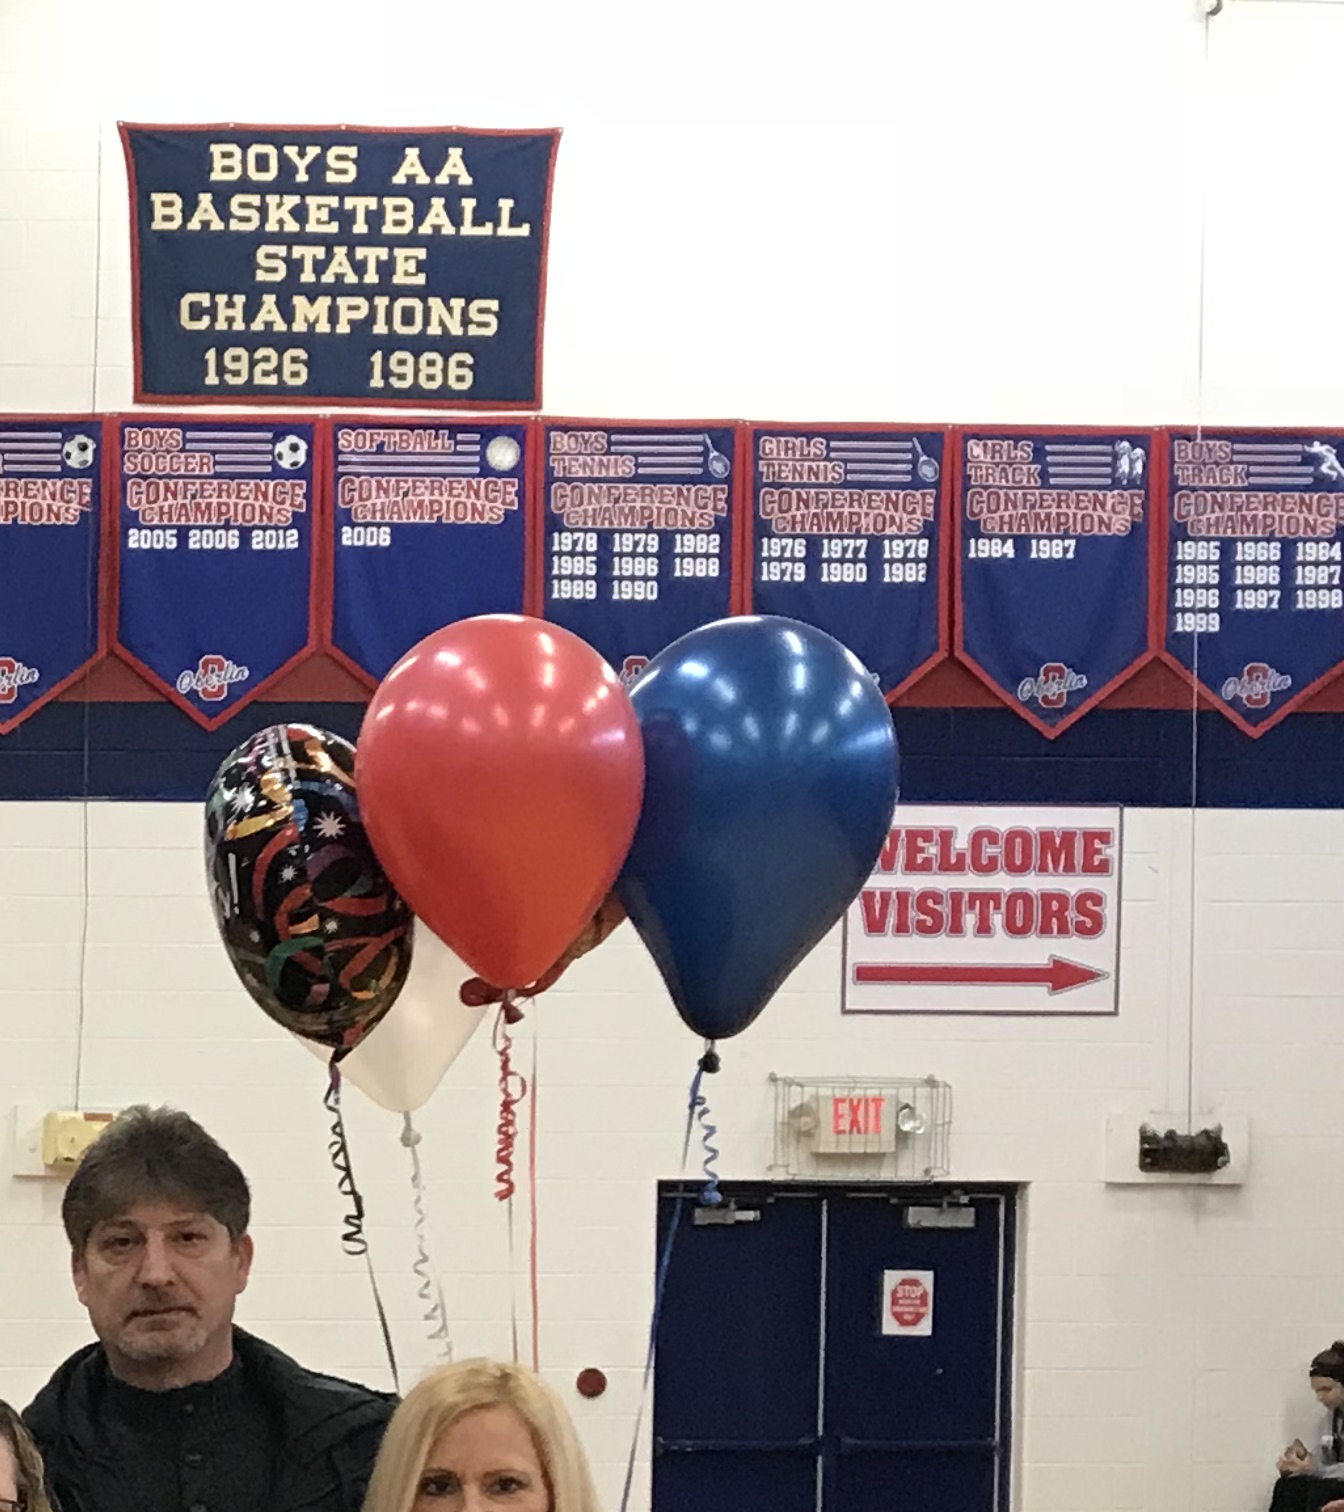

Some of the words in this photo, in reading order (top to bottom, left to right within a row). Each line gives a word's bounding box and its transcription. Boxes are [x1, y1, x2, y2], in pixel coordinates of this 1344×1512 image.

[210, 143, 358, 183] BOYS
[392, 148, 473, 185] AA
[151, 193, 530, 236] BASKETBALL
[255, 245, 426, 285] STATE
[179, 293, 499, 336] CHAMPIONS
[204, 347, 308, 386] 1926
[370, 350, 474, 390] 1986
[125, 428, 182, 450] BOYS
[338, 429, 454, 452] SOFTBALL
[550, 432, 608, 453] BOYS
[759, 437, 826, 459] GIRLS
[967, 440, 1033, 462] GIRLS
[1174, 440, 1233, 463] BOYS
[124, 453, 214, 474] SOCCER
[550, 456, 636, 477] TENNIS
[759, 461, 846, 483] TENNIS
[967, 464, 1041, 486] TRACK
[1174, 465, 1249, 487] TRACK
[127, 479, 307, 512] CONFERENCE
[339, 477, 518, 510] CONFERENCE
[551, 482, 728, 516] CONFERENCE
[760, 488, 937, 520] CONFERENCE
[140, 501, 293, 525] CHAMPIONS
[352, 499, 505, 524] CHAMPIONS
[564, 506, 715, 529] CHAMPIONS
[967, 489, 1145, 523] CONFERENCE
[773, 510, 924, 535] CHAMPIONS
[981, 512, 1131, 536] CHAMPIONS
[1188, 514, 1337, 538] CHAMPIONS
[128, 528, 178, 549] 2005
[188, 529, 240, 550] 2006
[251, 529, 299, 550] 2012
[341, 526, 392, 547] 2006
[552, 532, 598, 552] 1978
[612, 533, 659, 553] 1979
[761, 538, 806, 558] 1976
[822, 539, 868, 559] 1977
[883, 539, 929, 559] 1978
[968, 538, 1015, 559] 1984
[1030, 540, 1077, 559] 1987
[1296, 542, 1342, 562] 1984
[761, 562, 806, 582] 1979
[821, 563, 867, 583] 1980
[1295, 565, 1341, 585] 1987
[612, 581, 658, 600] 1990
[177, 661, 249, 693] Oberlin
[861, 888, 1107, 939] VISITORS
[832, 1097, 884, 1135] EXIT
[896, 1285, 923, 1298] STOP
